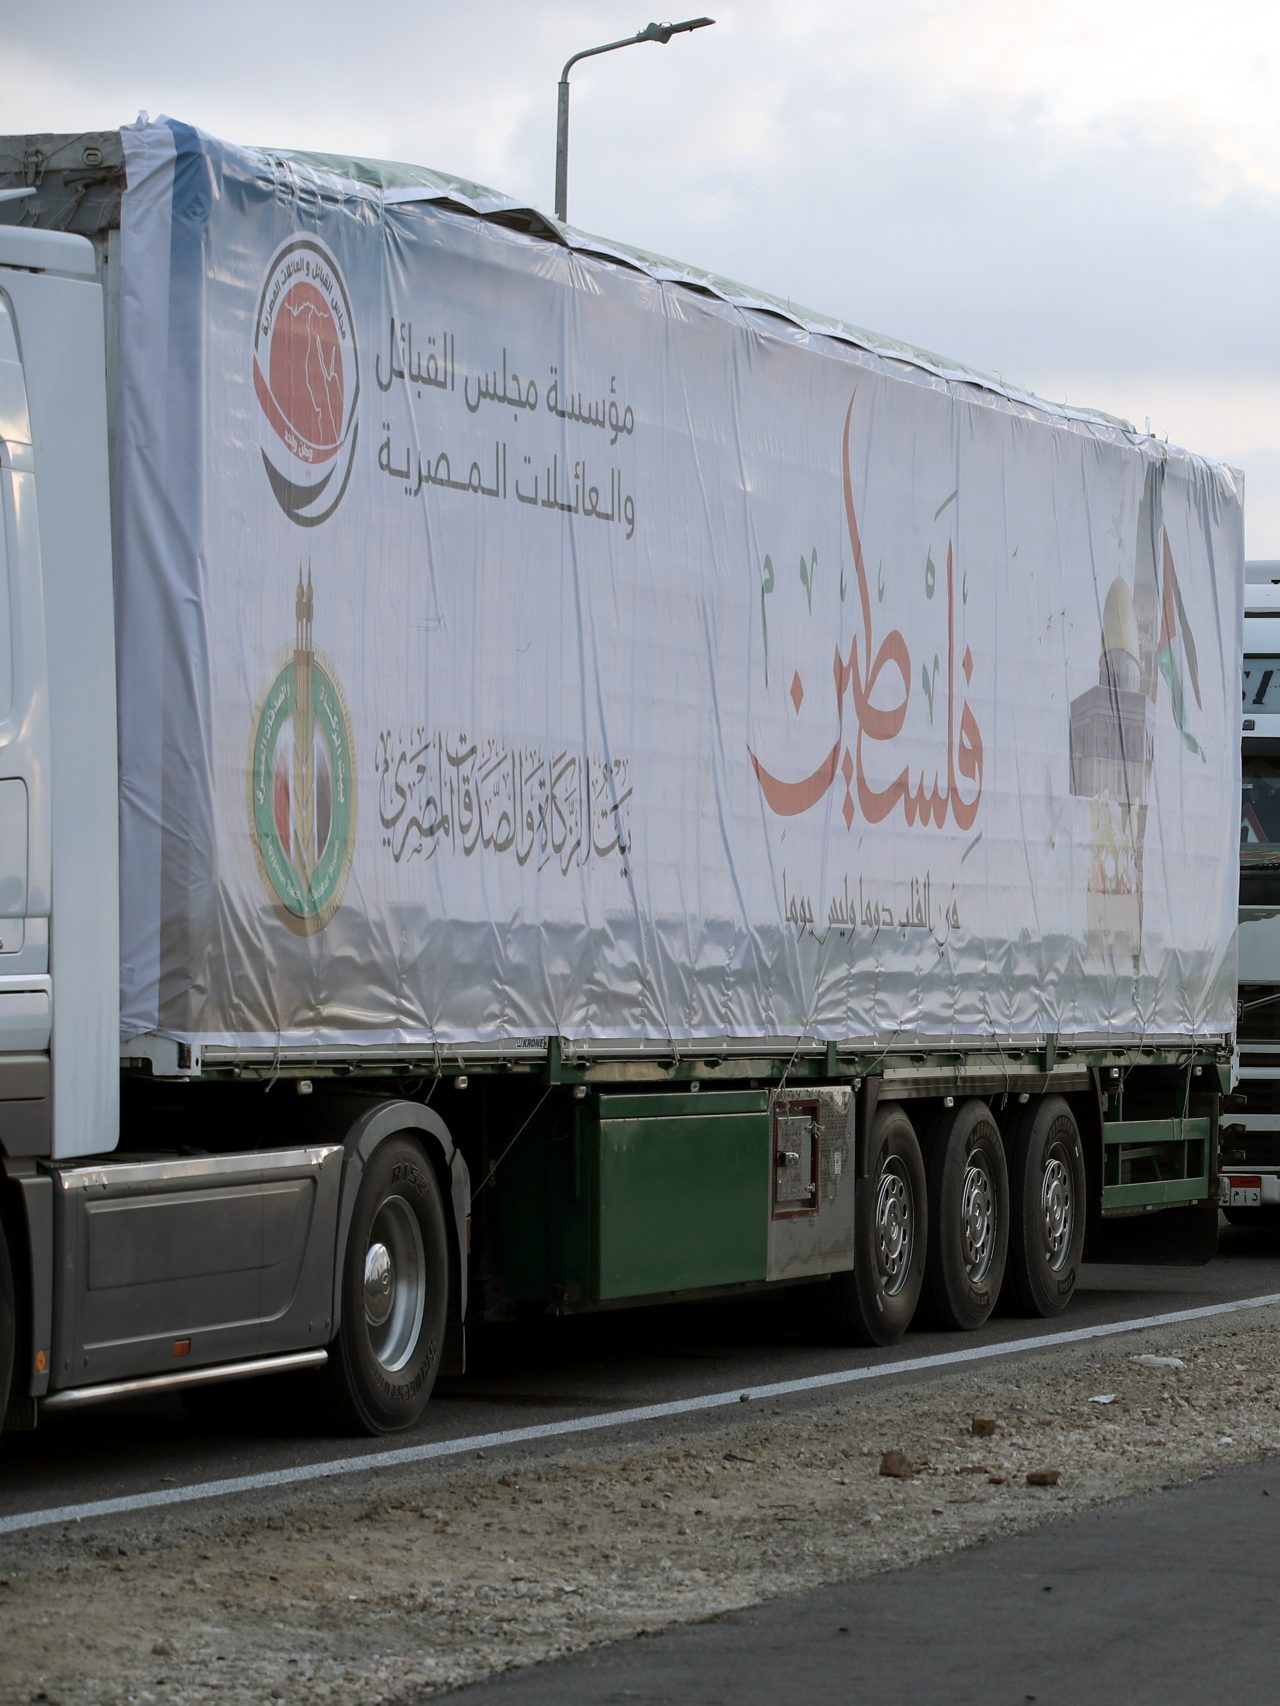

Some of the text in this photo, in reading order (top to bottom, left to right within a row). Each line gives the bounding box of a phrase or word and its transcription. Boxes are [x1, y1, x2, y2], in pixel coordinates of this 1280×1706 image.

[375, 317, 635, 446] مؤسسة مجلس القبائل
[377, 421, 636, 541] والعائلات المصرية
[746, 385, 984, 833] فلسطين
[898, 868, 935, 940] القلب
